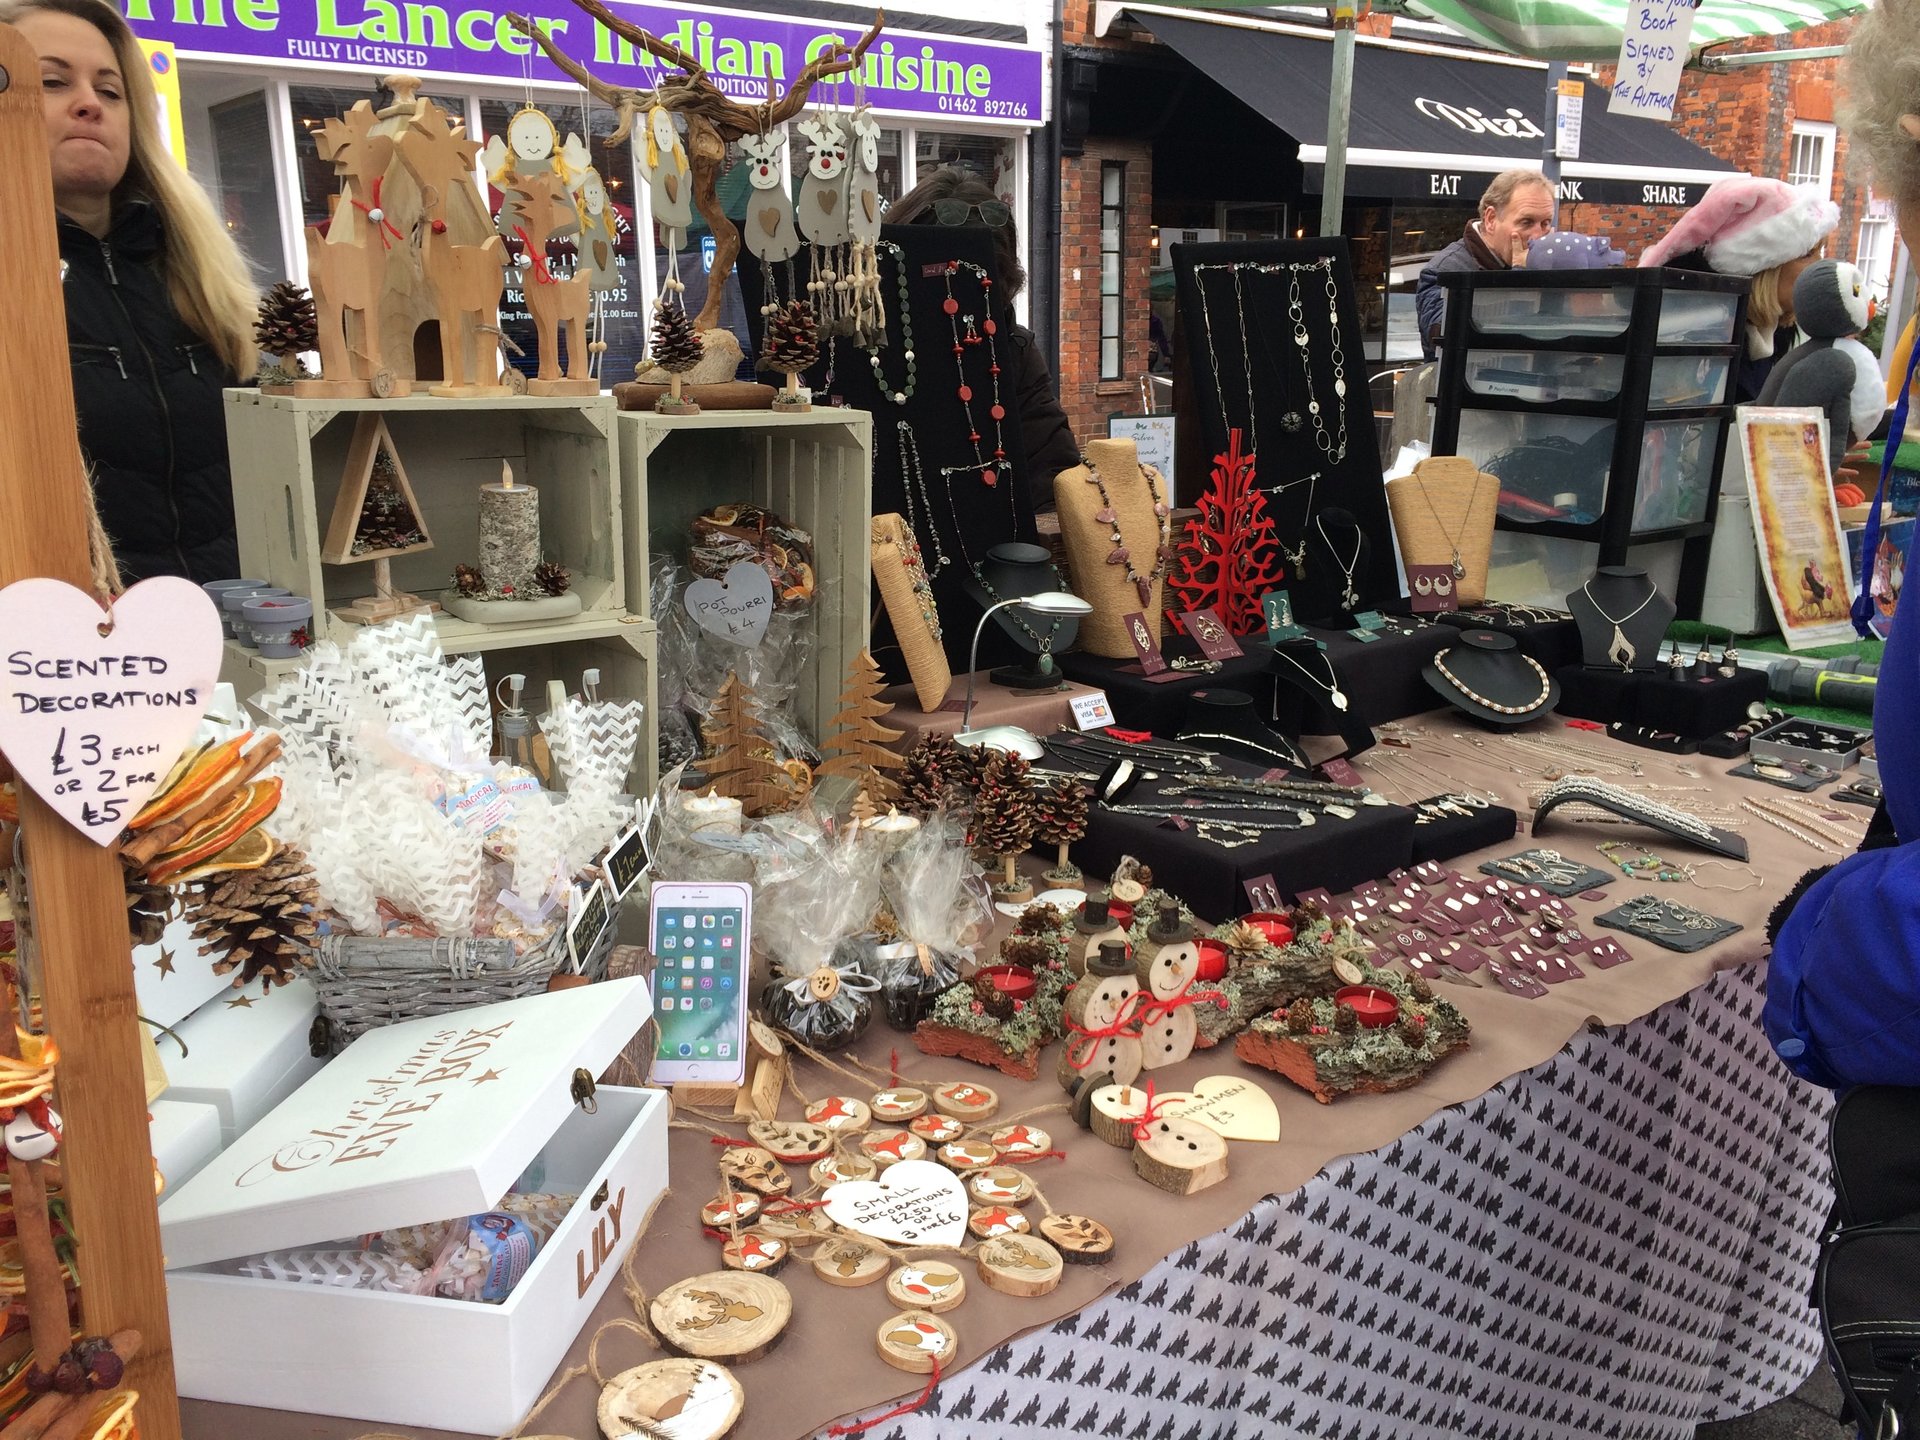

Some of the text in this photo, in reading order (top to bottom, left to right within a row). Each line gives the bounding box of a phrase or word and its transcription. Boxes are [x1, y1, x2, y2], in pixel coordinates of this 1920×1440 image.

[287, 38, 428, 67] FULLY LICENSED
[315, 0, 569, 58] Lancer
[804, 33, 991, 98] Cuisine
[1626, 38, 1675, 63] SIGNED
[1637, 63, 1656, 86] BY
[938, 96, 1028, 117] 01462 892766
[1614, 80, 1675, 112] THE AUTHOR
[1430, 174, 1686, 205] EAT SHARE
[621, 310, 638, 319] Extra
[698, 596, 728, 614] POT
[718, 596, 767, 618] POURRI
[8, 650, 168, 679] SCENTED
[12, 688, 198, 714] DECORATIONS
[1074, 698, 1105, 710] WE ACCEPT
[1081, 710, 1094, 718] VISA
[111, 743, 160, 761] EACH
[54, 770, 157, 796] OR 2 FOR
[81, 798, 129, 827] £5
[329, 1020, 515, 1166] EVE BOX
[1169, 1084, 1246, 1119] SNOWMEN
[234, 1029, 457, 1188] Christmas
[853, 1186, 921, 1212] SMALL
[853, 1187, 954, 1225] DECORATIONS
[913, 1214, 933, 1225] OR
[576, 1187, 625, 1300] LILY
[901, 1229, 919, 1240] 3
